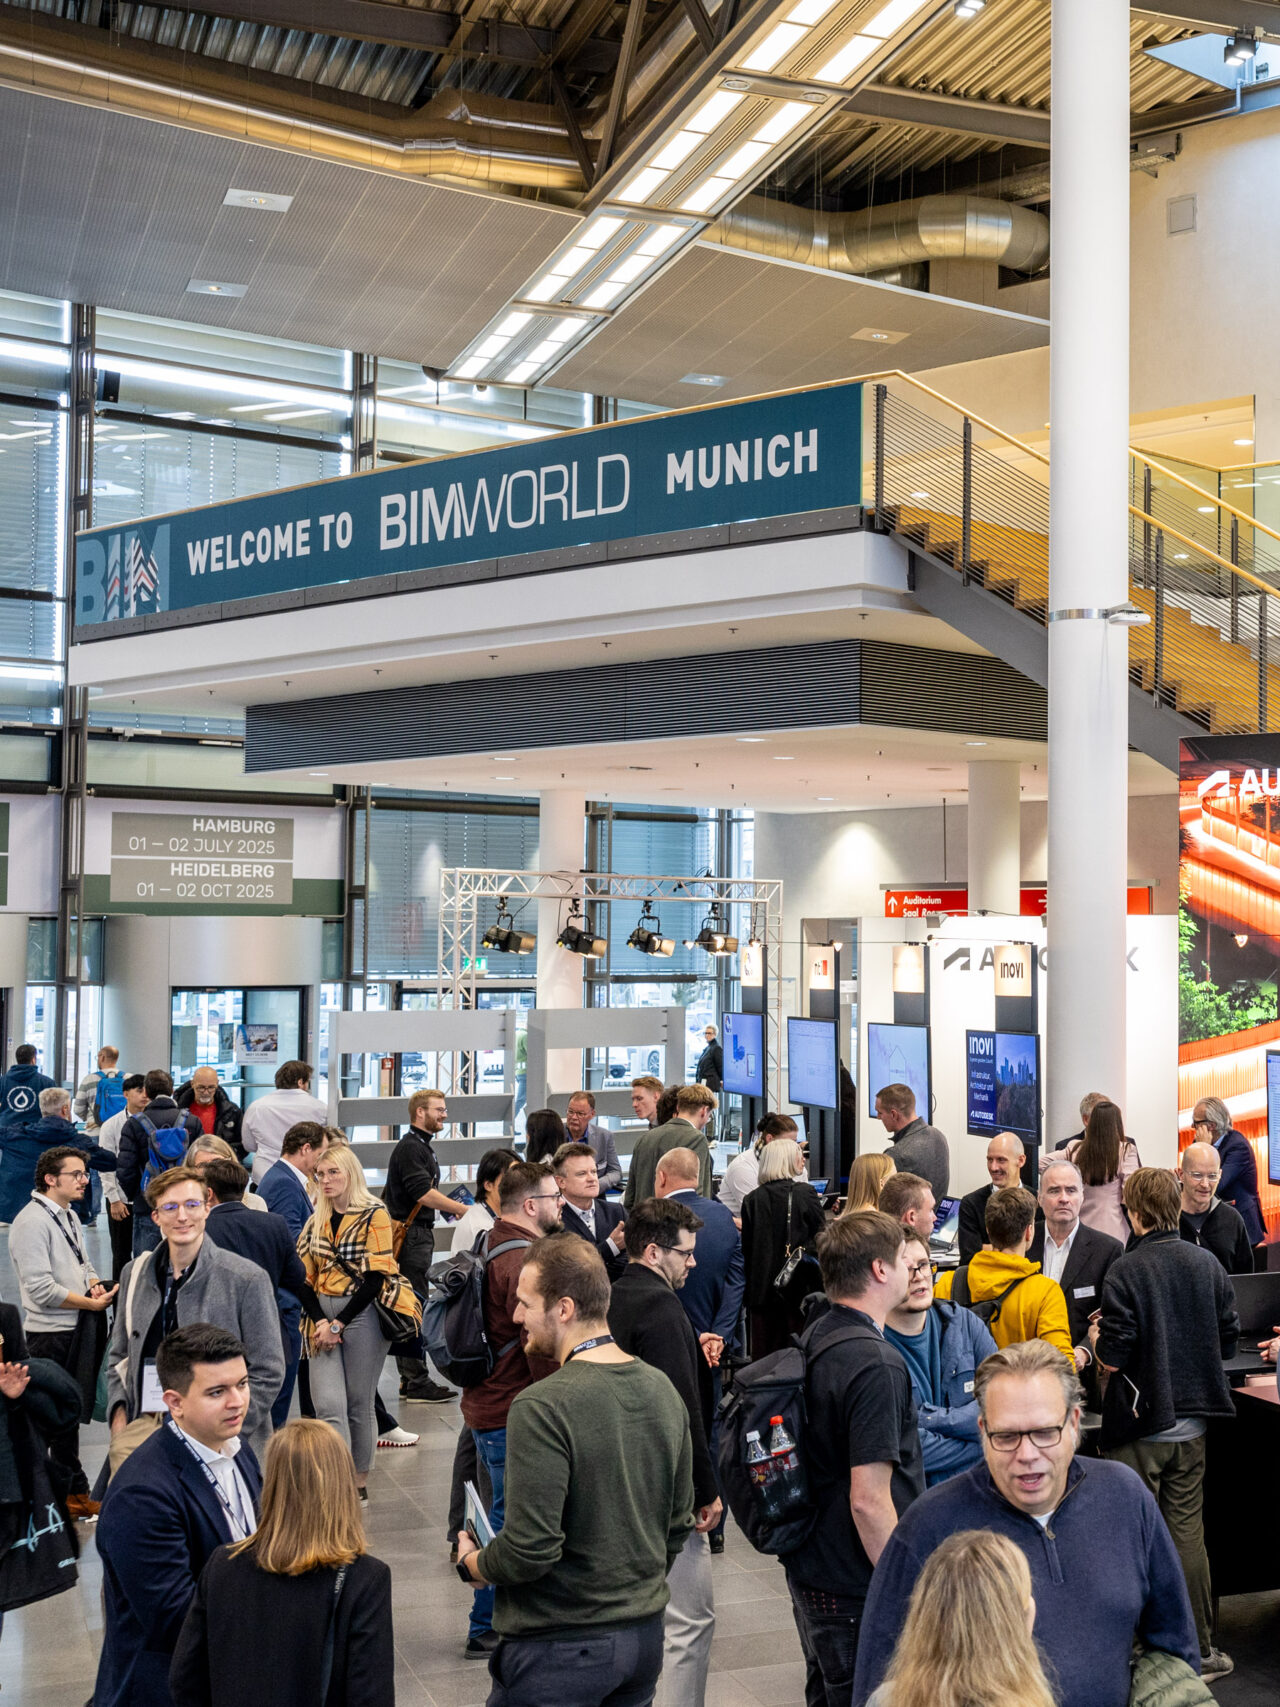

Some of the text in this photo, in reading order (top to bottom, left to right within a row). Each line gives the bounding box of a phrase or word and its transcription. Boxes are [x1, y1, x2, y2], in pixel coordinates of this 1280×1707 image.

[187, 428, 818, 576] WELCOME TO BIMWORLD MUNICH
[192, 817, 276, 834] HAMBURG
[128, 836, 147, 851] 01
[169, 837, 189, 852] 02
[193, 838, 235, 854] JULY
[237, 839, 275, 855] 2025
[170, 862, 275, 878] HEIDELBERG
[136, 881, 154, 897] 01
[176, 882, 197, 897] 02
[201, 883, 233, 898] OCT
[236, 883, 274, 898] 2025
[903, 895, 942, 905] Auditorium
[902, 908, 919, 918] Saal
